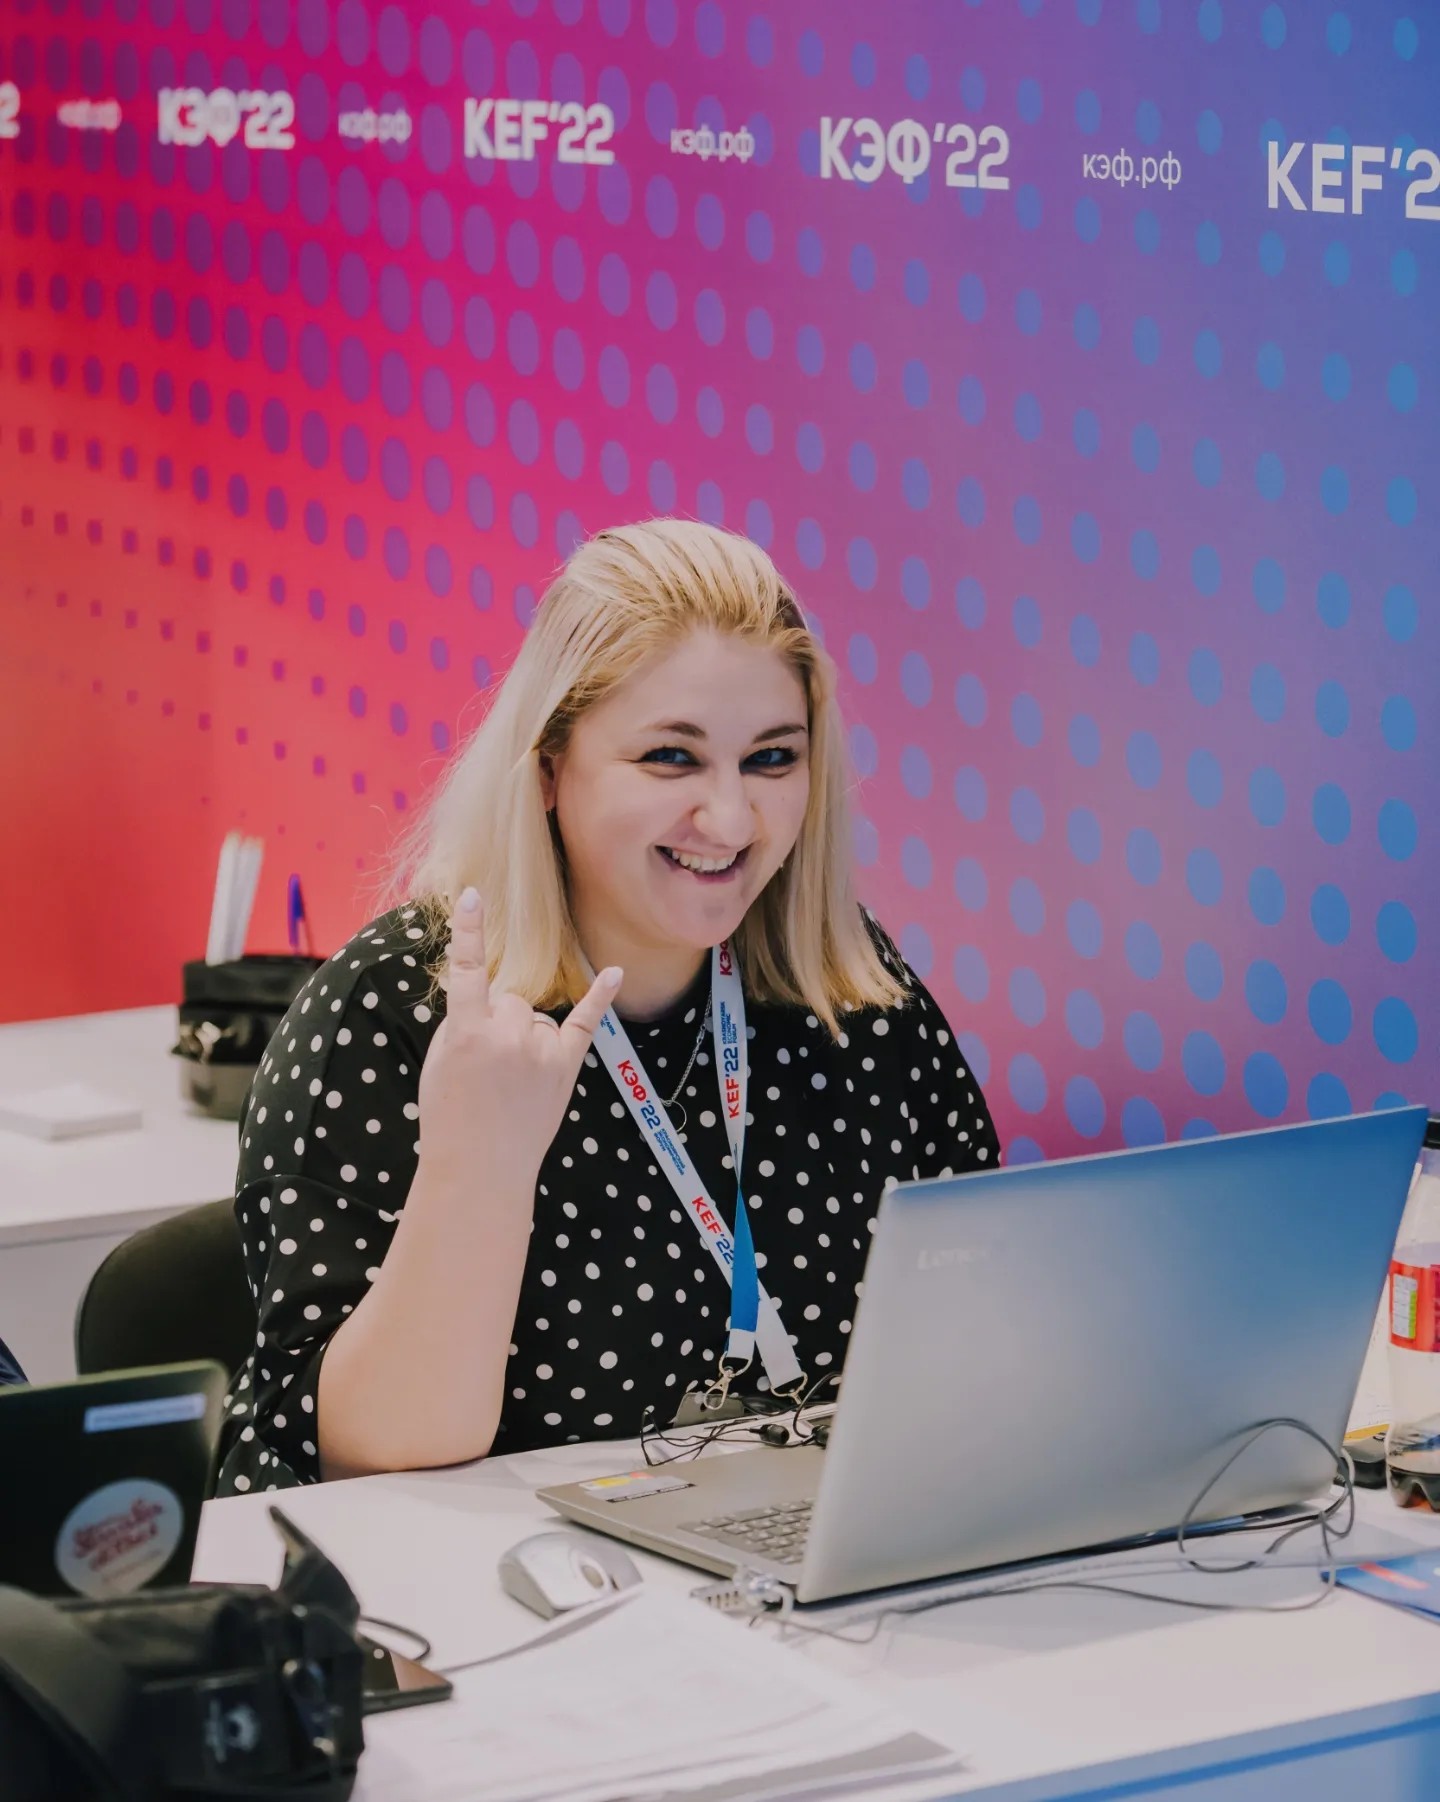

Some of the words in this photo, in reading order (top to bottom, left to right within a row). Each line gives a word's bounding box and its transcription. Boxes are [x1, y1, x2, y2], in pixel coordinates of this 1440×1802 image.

[463, 97, 615, 166] KEF'22
[670, 124, 756, 164] кэф.рф
[819, 116, 1010, 190] КЭФ'22
[1082, 149, 1183, 190] кэф.рф
[617, 1059, 661, 1130] КЭФ'22
[724, 1045, 740, 1119] KEF'22
